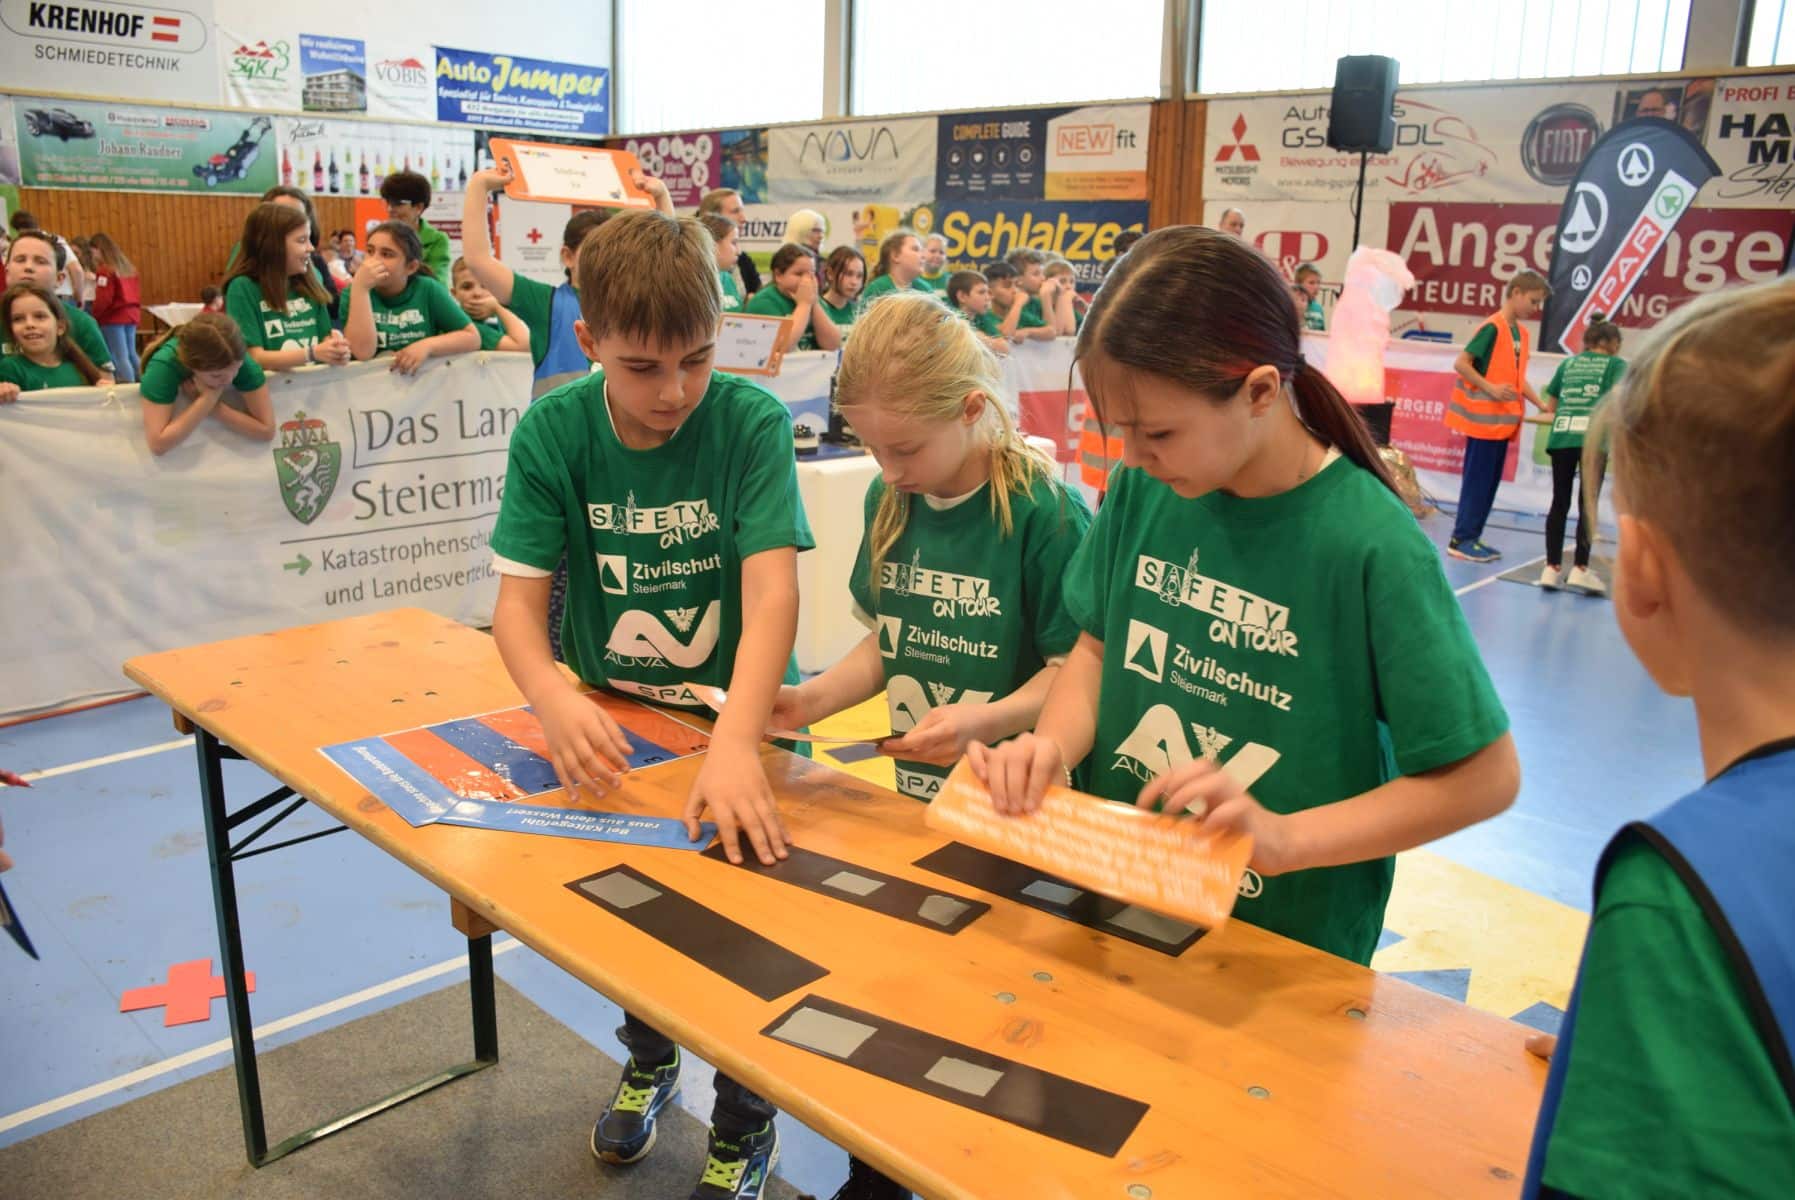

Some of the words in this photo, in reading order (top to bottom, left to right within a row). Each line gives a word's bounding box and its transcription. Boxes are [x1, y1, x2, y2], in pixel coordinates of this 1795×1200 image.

[29, 2, 145, 38] KRENHOF
[35, 44, 180, 71] SCHMIEDETECHNIK
[374, 63, 427, 84] VOBIS
[436, 57, 491, 83] Auto
[491, 56, 604, 98] Jumper
[1725, 85, 1779, 102] PROFI
[953, 123, 1001, 141] COMPLETE
[1002, 121, 1031, 139] GUIDE
[1059, 129, 1109, 151] NEW
[1116, 129, 1137, 148] fit
[1542, 128, 1589, 164] FIAT
[943, 211, 1144, 261] Schlatze
[360, 409, 439, 450] Das
[453, 399, 520, 439] Lan
[352, 474, 506, 521] Steierma
[591, 502, 705, 531] SAFETY
[660, 528, 683, 549] ON
[683, 512, 720, 542] TOUR
[632, 554, 721, 580] Zivilschut
[880, 563, 985, 598] SAFETY
[325, 582, 364, 606] und
[633, 580, 687, 594] Steiermark
[1142, 561, 1283, 626] SAFETY
[933, 599, 956, 619] ON
[958, 597, 1002, 617] TOUR
[906, 625, 999, 659] Zivilschutz
[1208, 619, 1238, 649] ON
[1240, 624, 1299, 657] TOUR
[604, 651, 669, 669] AUVA
[904, 646, 951, 665] Steiermark
[1170, 670, 1228, 706] Steiermark
[1172, 643, 1293, 712] Zivilschutz
[638, 685, 698, 702] SPA
[565, 814, 597, 823] dem
[600, 818, 625, 826] aus
[627, 821, 660, 830] raus
